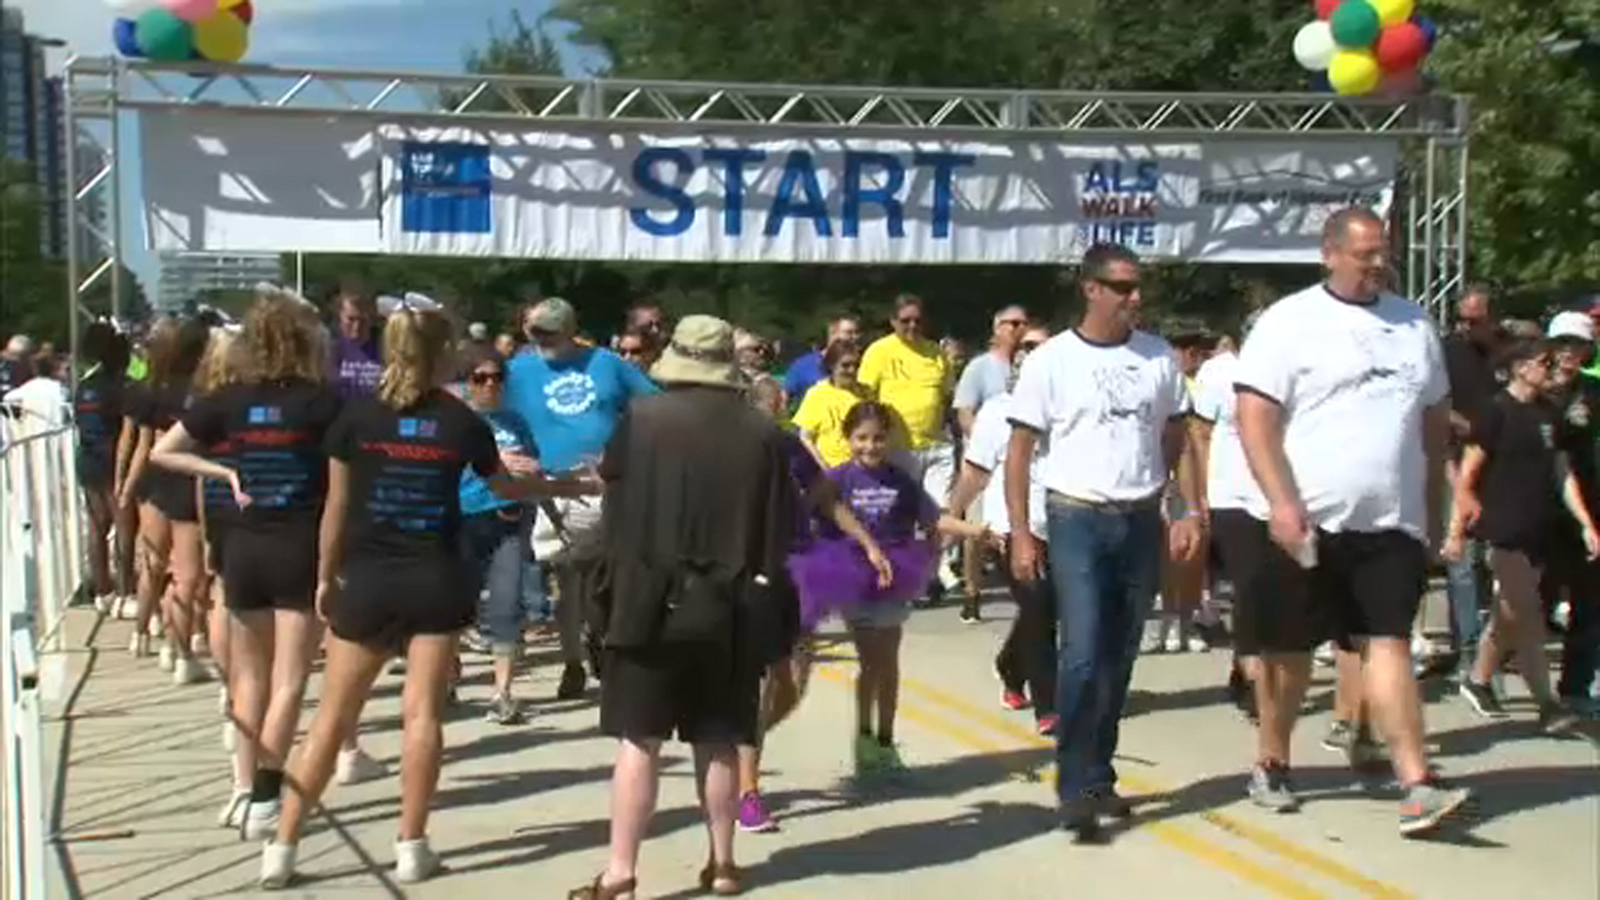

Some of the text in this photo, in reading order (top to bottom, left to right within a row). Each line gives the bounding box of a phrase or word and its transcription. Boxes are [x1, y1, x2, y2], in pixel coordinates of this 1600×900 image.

[631, 147, 976, 239] START
[1083, 160, 1159, 193] ALS
[1081, 196, 1156, 217] WALK
